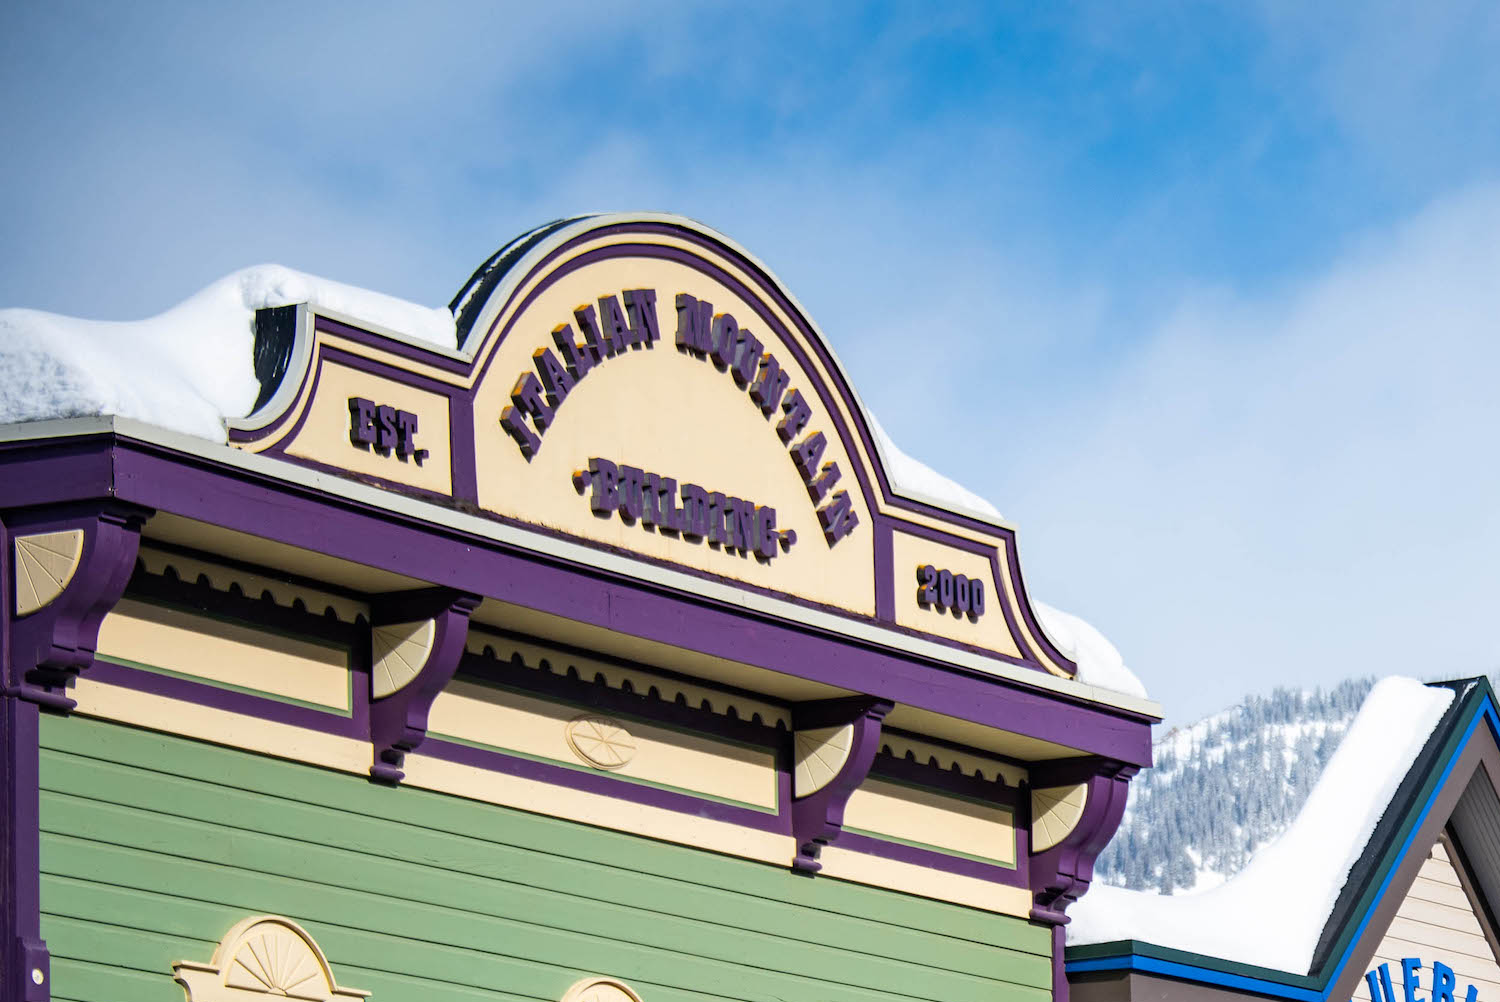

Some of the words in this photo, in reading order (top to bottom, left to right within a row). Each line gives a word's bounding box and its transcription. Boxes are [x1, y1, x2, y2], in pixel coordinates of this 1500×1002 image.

[347, 397, 429, 467] EST.
[499, 288, 661, 464] ITALIAN
[675, 293, 860, 550] MOUNTAIN
[588, 457, 779, 565] BUILDING
[916, 564, 985, 624] 2000
